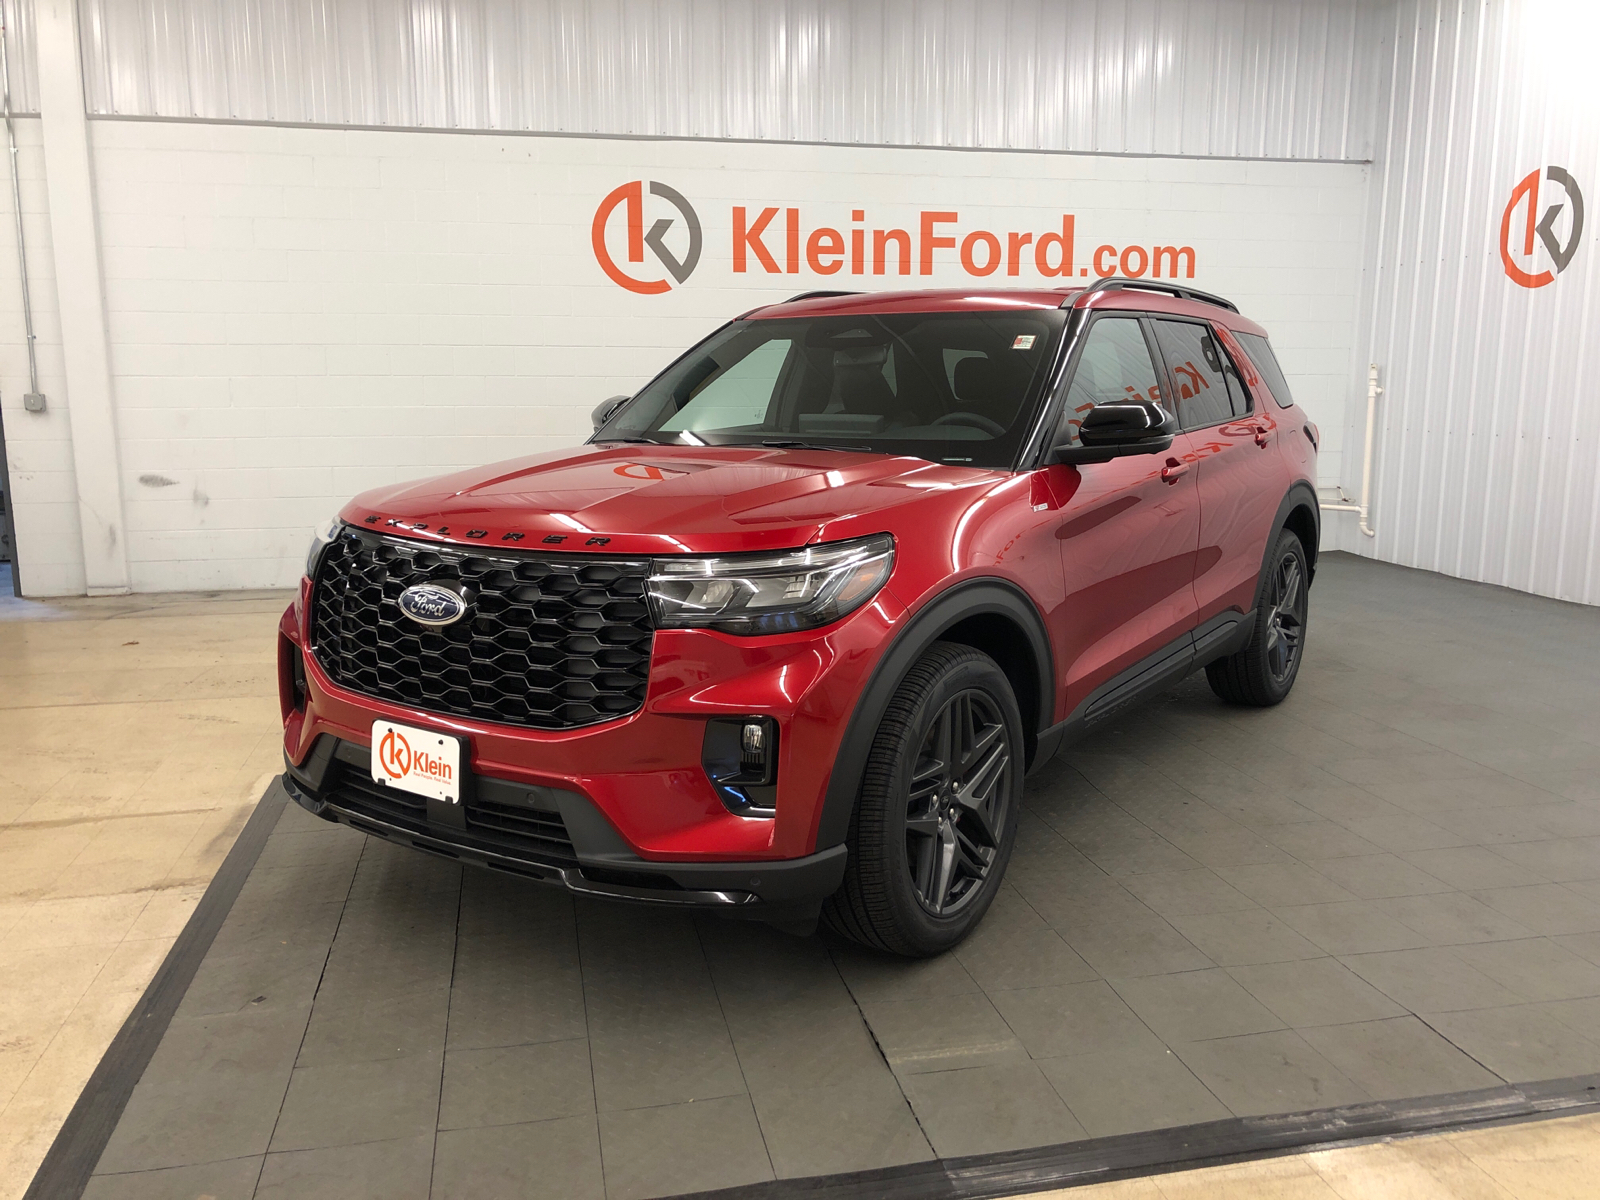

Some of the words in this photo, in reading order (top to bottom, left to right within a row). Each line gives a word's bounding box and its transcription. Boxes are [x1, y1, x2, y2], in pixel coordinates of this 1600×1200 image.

[732, 206, 1196, 279] KleinFord.com
[364, 515, 611, 547] EXPLORER
[410, 592, 446, 617] Ford
[414, 750, 452, 779] Klein
